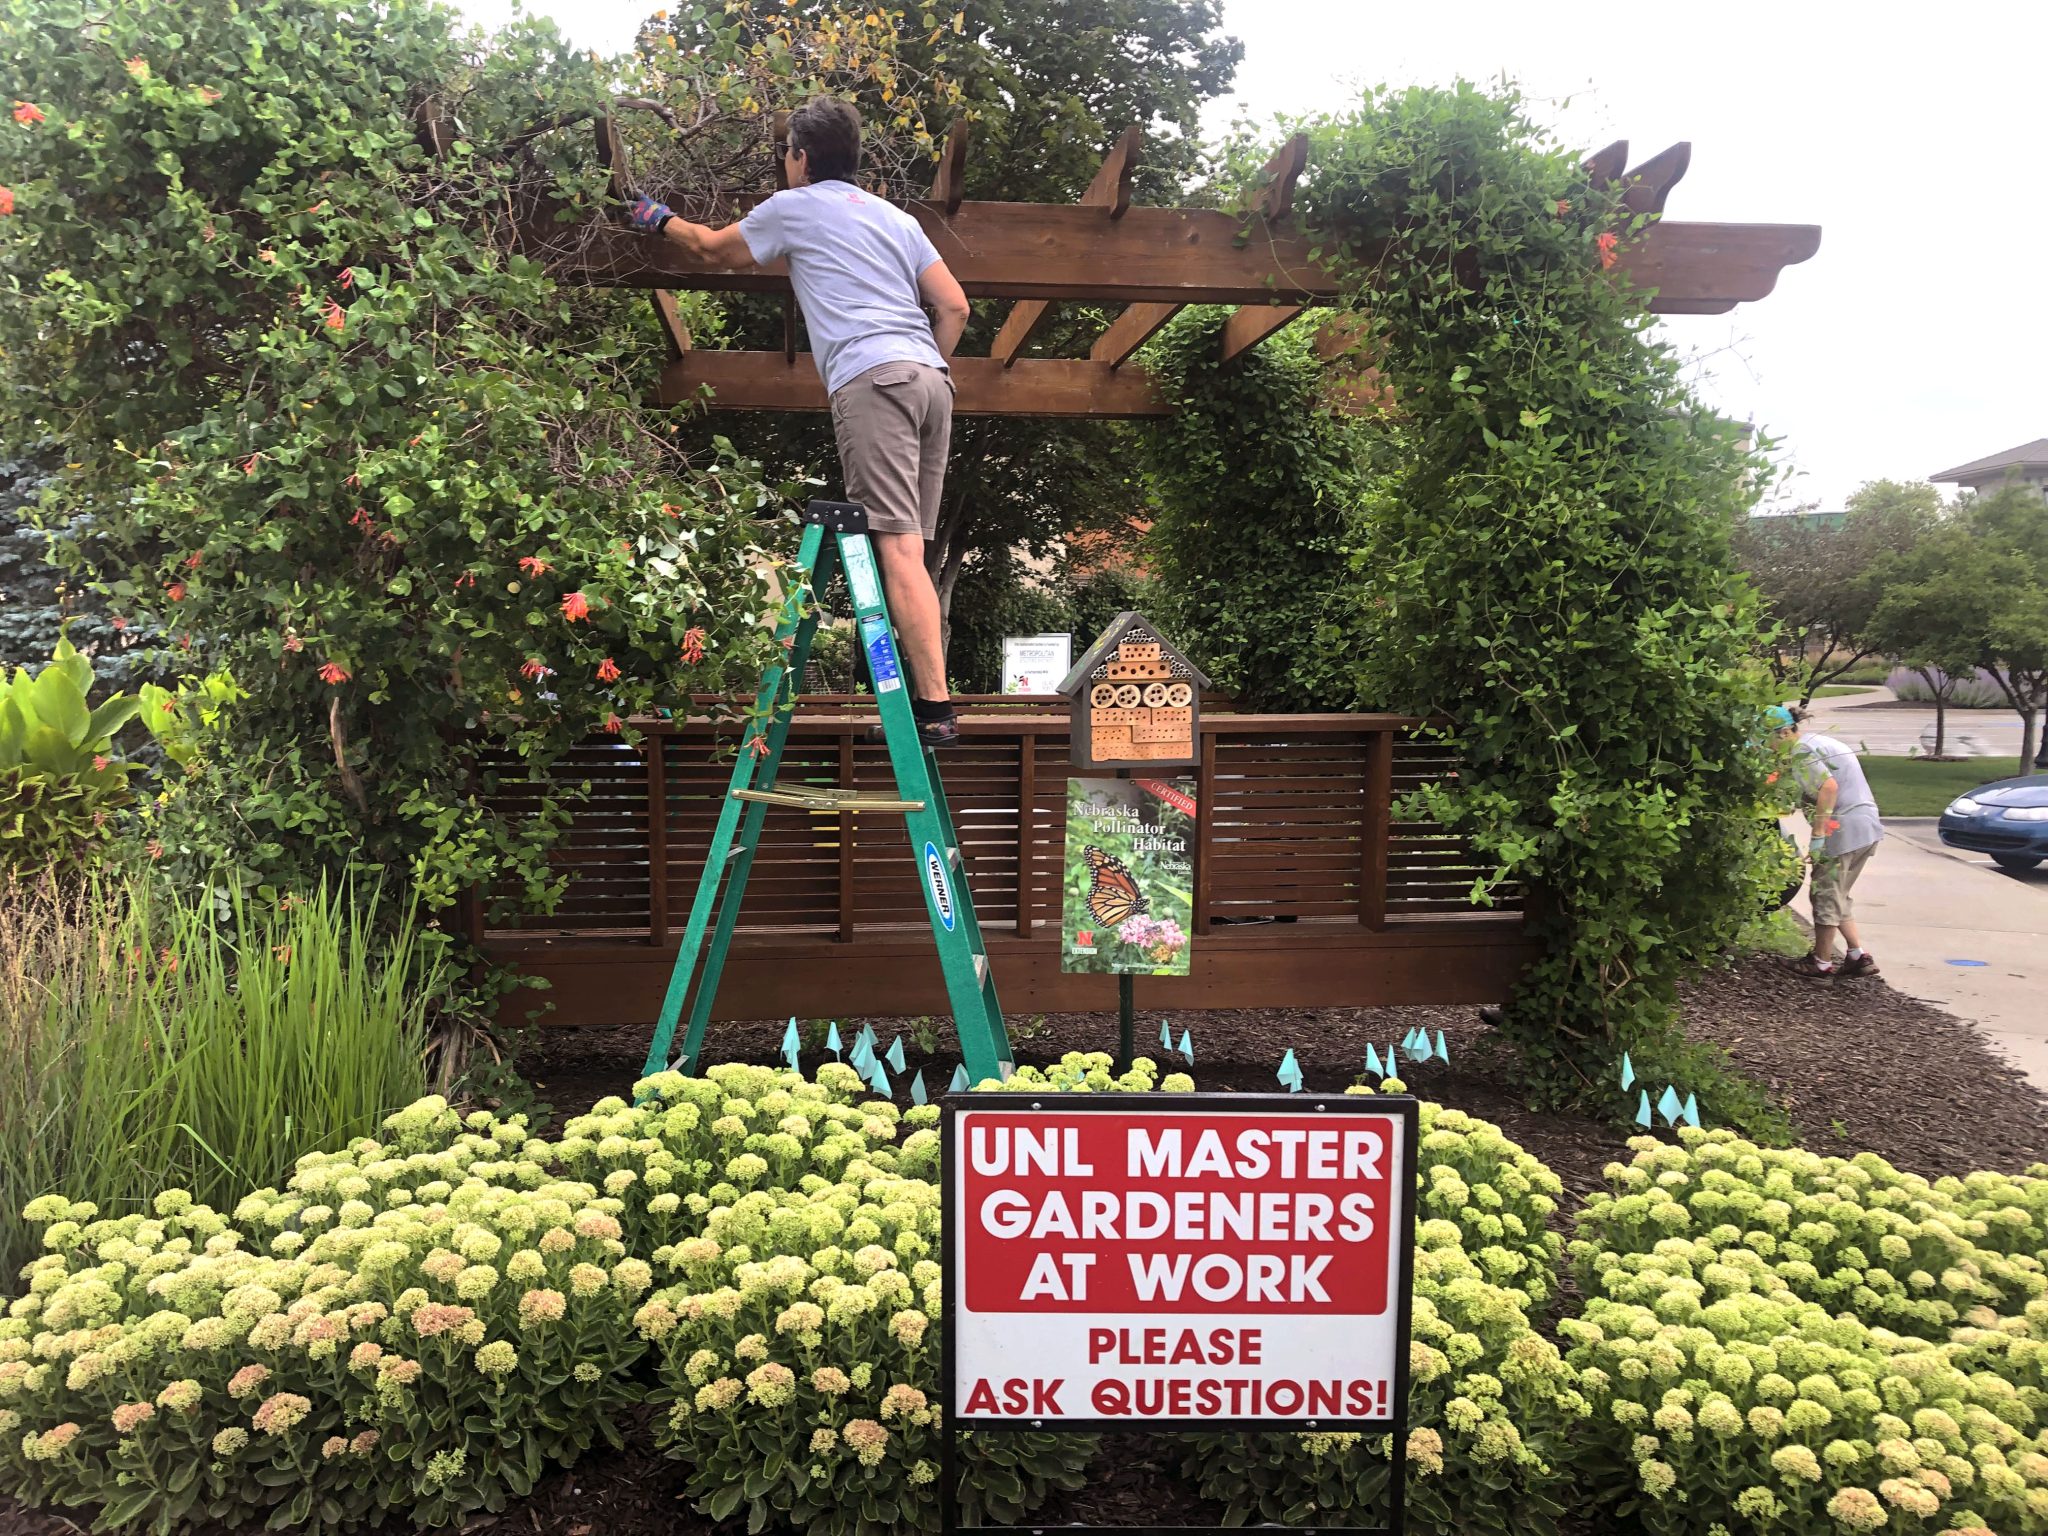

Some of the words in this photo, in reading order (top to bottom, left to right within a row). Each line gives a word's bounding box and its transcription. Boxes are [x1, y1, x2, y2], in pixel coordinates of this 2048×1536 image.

[1073, 803, 1140, 817] Nebraska
[1150, 782, 1194, 811] CERTIFIED
[1093, 820, 1166, 835] Pollinator
[1133, 838, 1186, 852] Habitat
[930, 860, 950, 913] WERNER
[1077, 931, 1093, 946] N
[970, 1126, 1094, 1177] UNL
[1127, 1127, 1384, 1180] MASTER
[980, 1189, 1375, 1243] GARDENERS
[1019, 1252, 1097, 1302] AT
[1126, 1253, 1334, 1304] WORK
[1088, 1327, 1262, 1366] PLEASE
[964, 1378, 1065, 1415] ASK
[1091, 1378, 1388, 1417] QUESTIONS!
